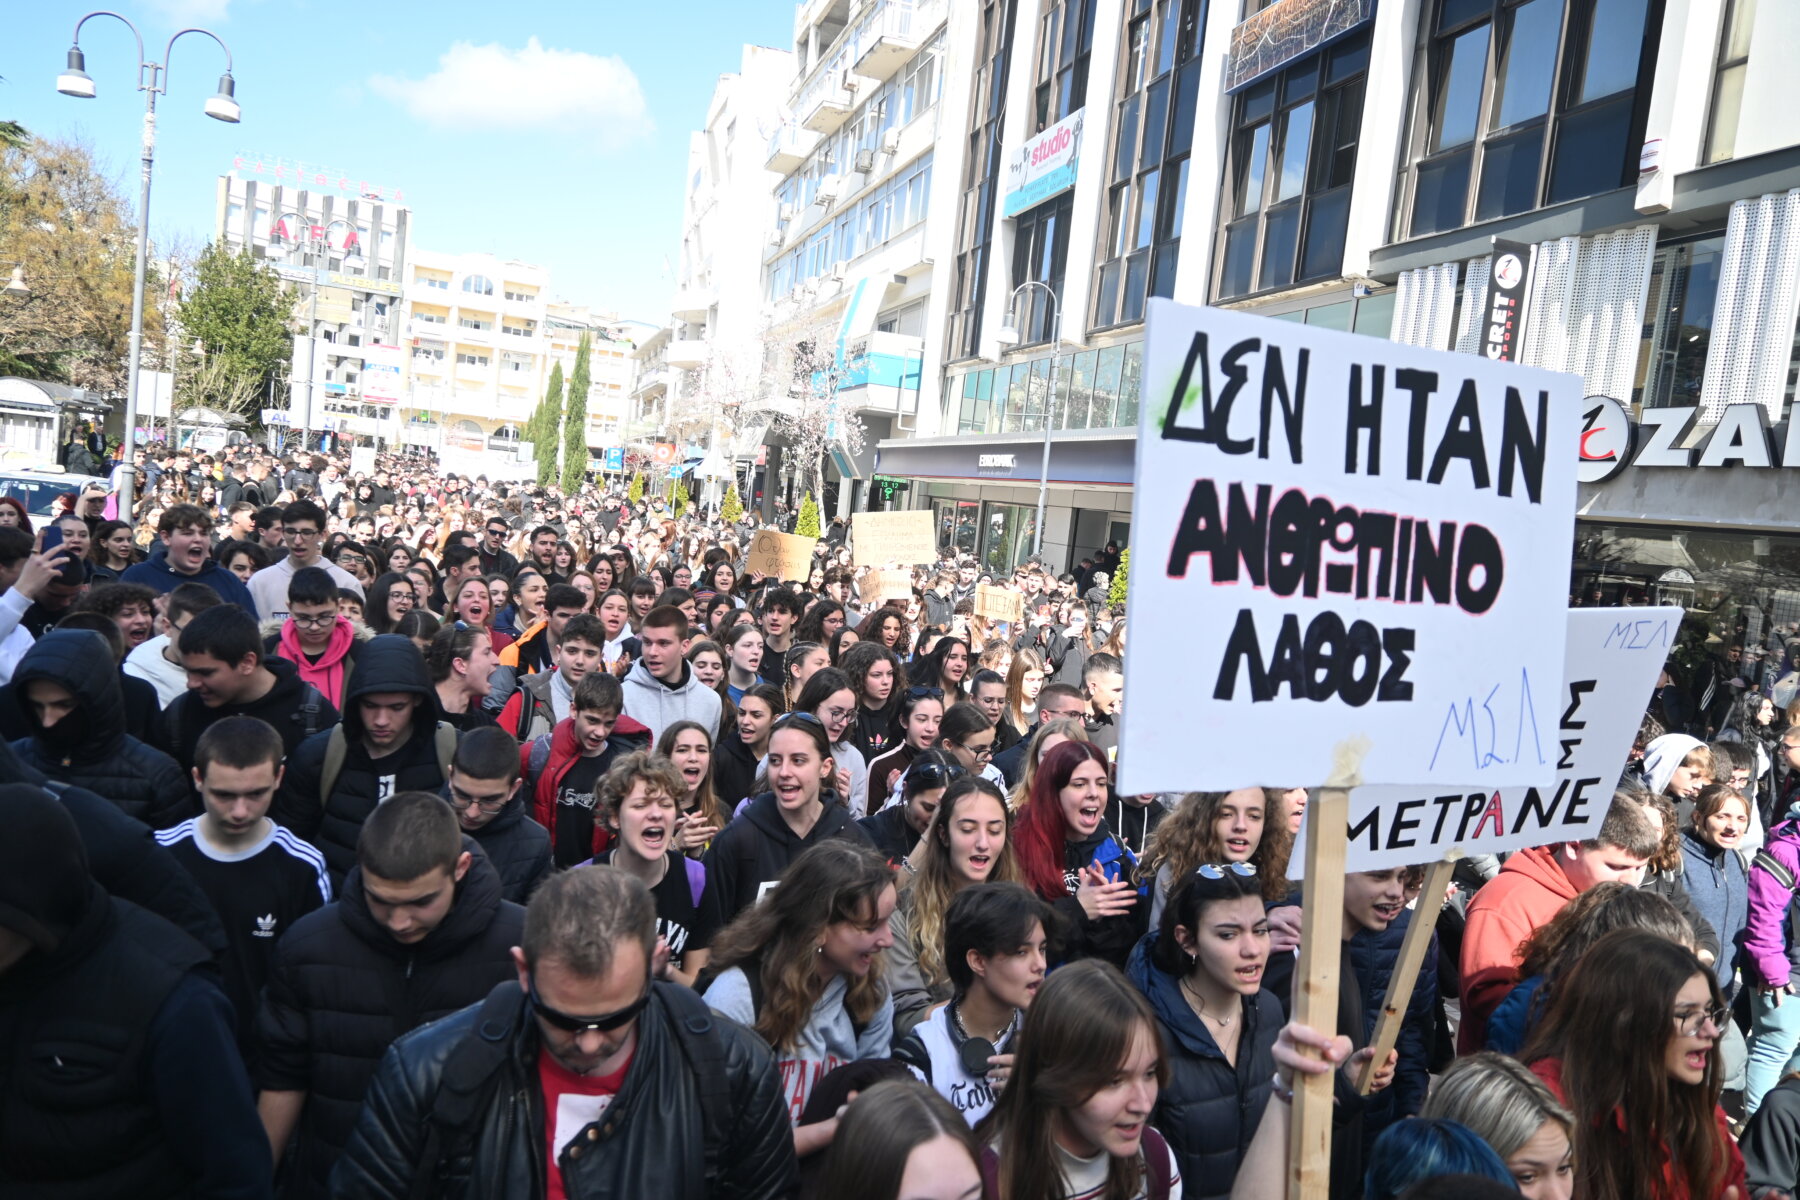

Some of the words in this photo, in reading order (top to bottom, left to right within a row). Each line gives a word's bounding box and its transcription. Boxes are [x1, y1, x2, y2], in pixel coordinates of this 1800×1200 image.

[1030, 126, 1071, 167] studio
[1486, 292, 1510, 360] CRET
[1161, 330, 1311, 464] ΔΕΝ
[1344, 362, 1549, 505] ΗΤΑΝ
[1632, 401, 1800, 467] ZA
[1165, 478, 1504, 616] ΑΝΘΡΩΠΙΝΟ
[1212, 608, 1416, 707] ΛΑΘΟΣ
